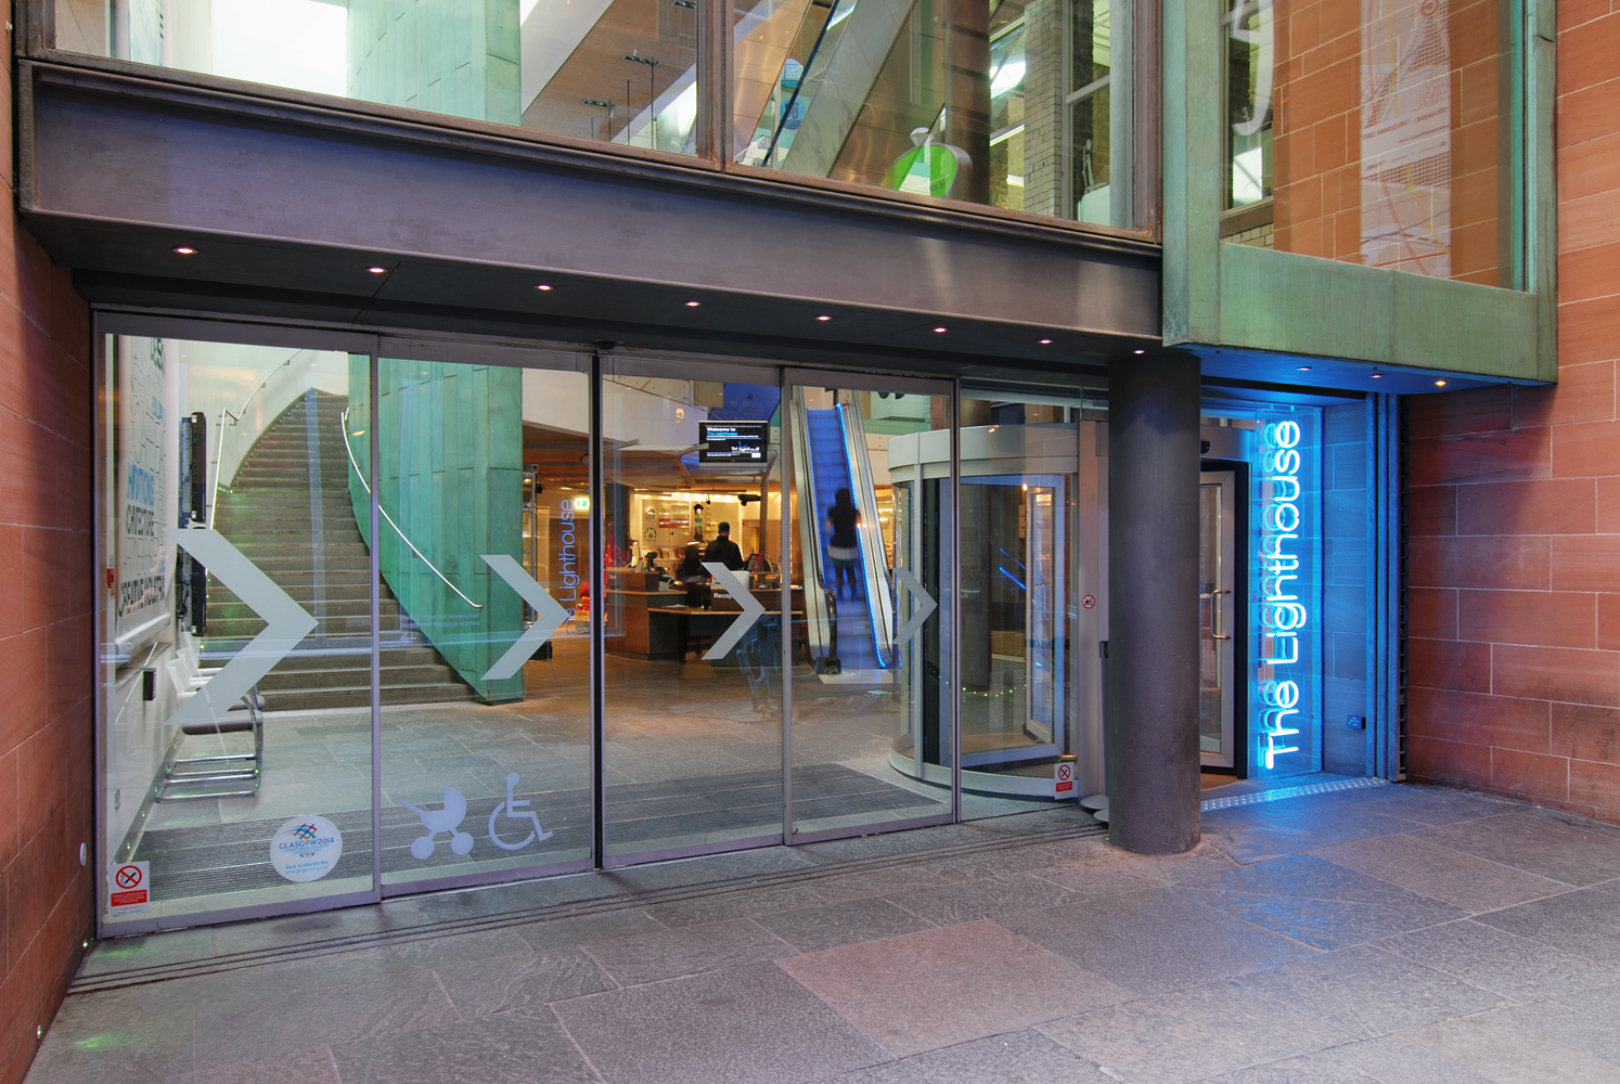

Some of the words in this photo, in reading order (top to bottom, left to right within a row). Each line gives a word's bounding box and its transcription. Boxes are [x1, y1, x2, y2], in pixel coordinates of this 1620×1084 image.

[558, 499, 580, 602] Lighthouse
[1266, 420, 1306, 665] Lighthouse
[1266, 681, 1299, 770] The
